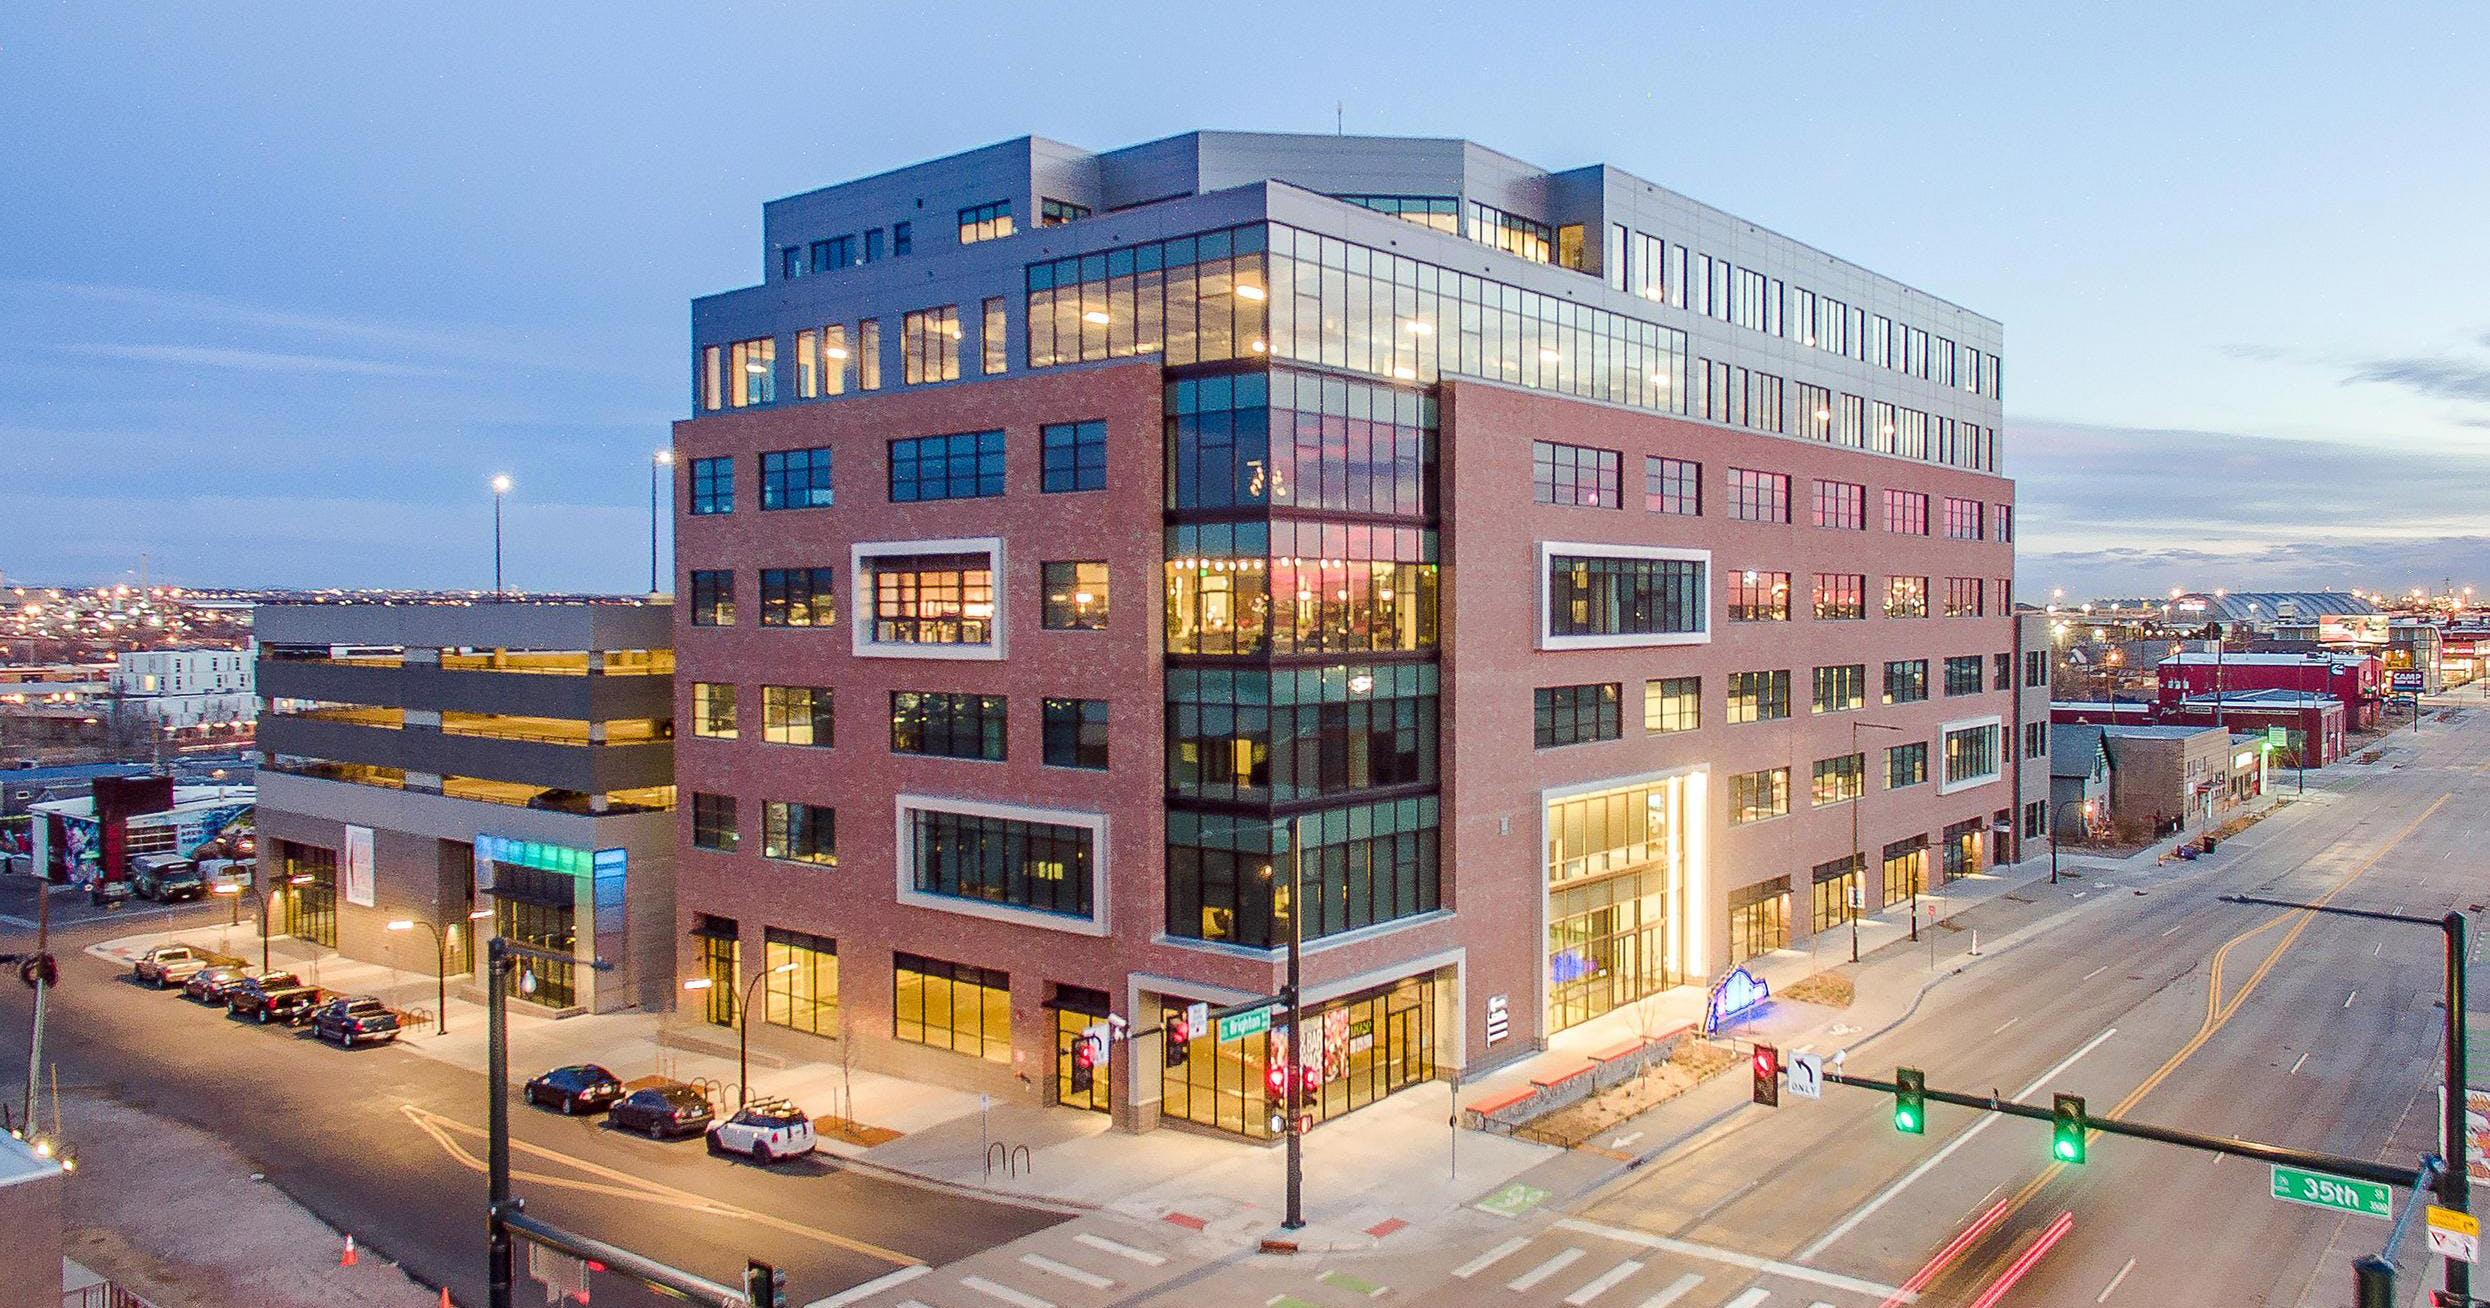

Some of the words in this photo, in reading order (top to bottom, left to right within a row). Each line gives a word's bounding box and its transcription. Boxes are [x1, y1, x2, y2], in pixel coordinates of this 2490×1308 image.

[1229, 1014, 1261, 1037] Brighton
[1791, 1082, 1816, 1095] ONLY
[2303, 1177, 2359, 1208] 35th
